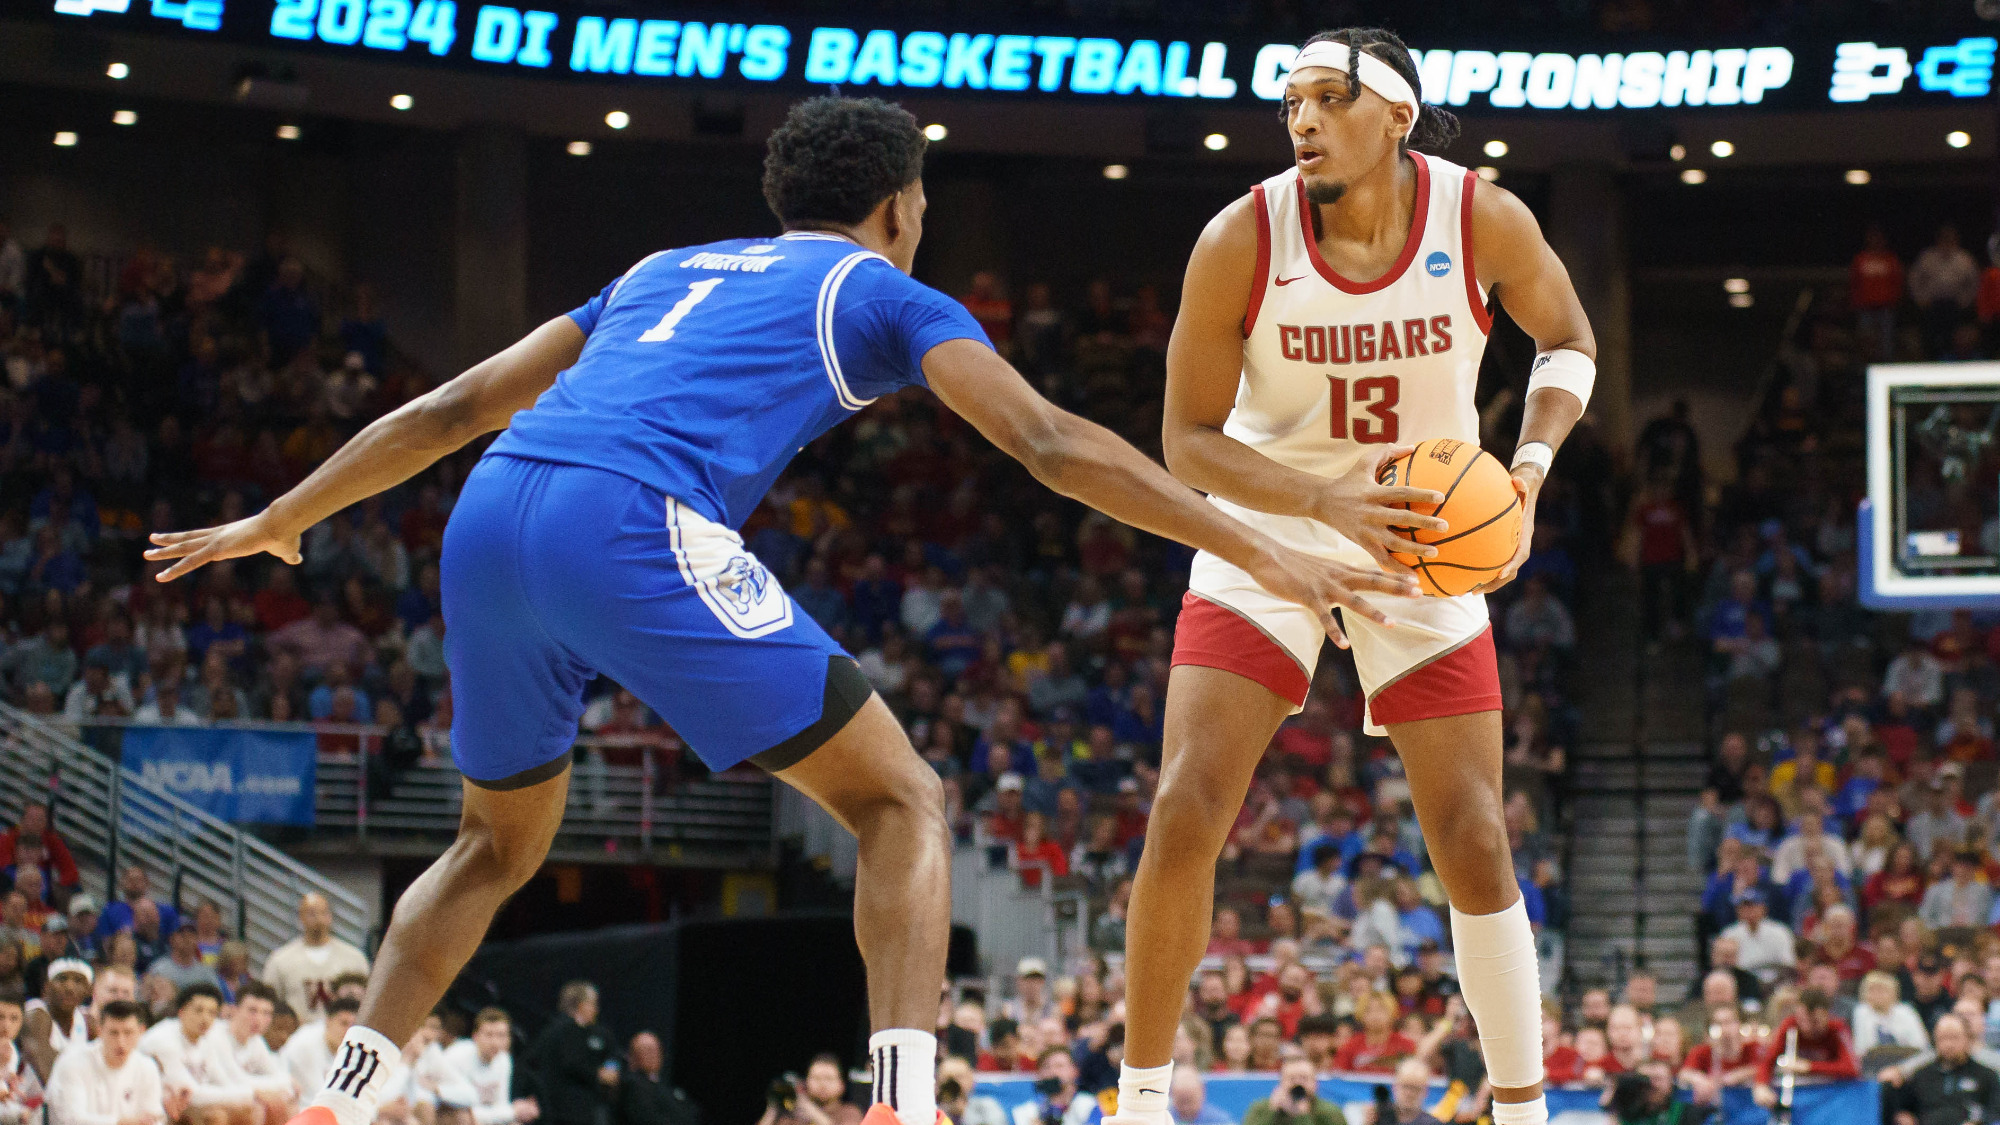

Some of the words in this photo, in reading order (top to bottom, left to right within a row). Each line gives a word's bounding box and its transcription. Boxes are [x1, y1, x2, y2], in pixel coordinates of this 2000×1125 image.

[269, 0, 458, 56] 2024
[471, 5, 559, 68] DI
[569, 15, 792, 81] MEN'S
[804, 26, 1237, 98] BASKETBALL
[1251, 44, 1794, 110] CMPIONSHIP
[1429, 262, 1451, 272] NCAA
[637, 277, 725, 342] 1
[1277, 313, 1453, 365] COUGARS
[1326, 373, 1401, 445] 13
